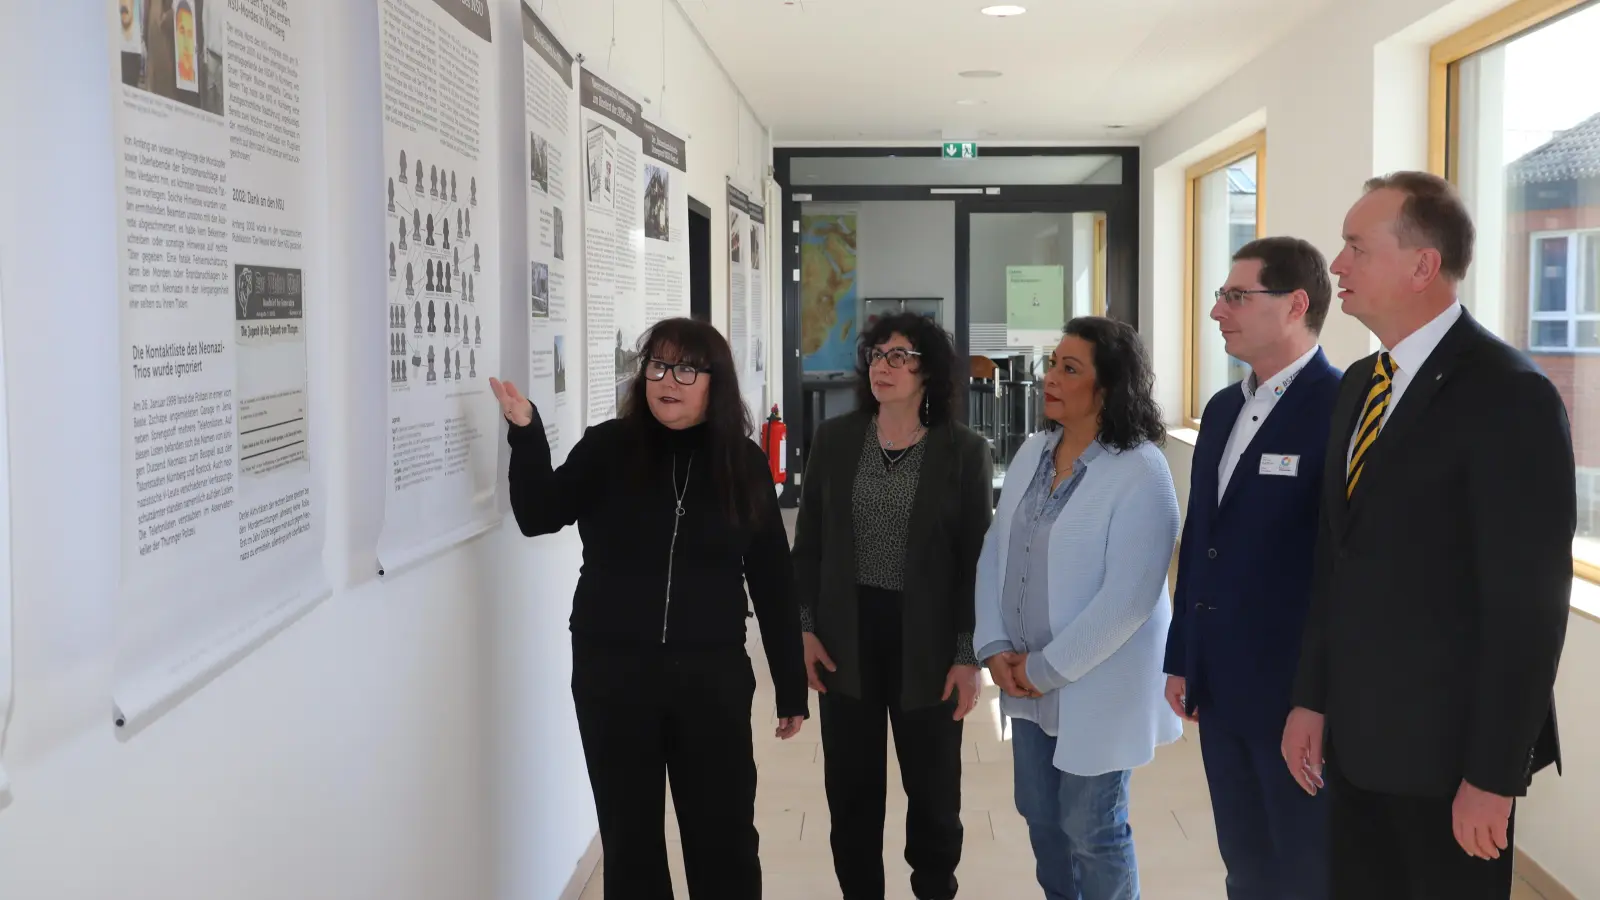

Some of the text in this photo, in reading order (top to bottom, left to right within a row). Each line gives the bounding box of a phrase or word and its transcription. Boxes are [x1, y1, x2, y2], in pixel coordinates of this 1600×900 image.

[471, 0, 483, 16] NSU
[247, 191, 260, 205] Dank
[261, 197, 266, 207] an
[267, 196, 275, 208] den
[276, 198, 284, 210] NSU
[132, 340, 225, 360] Die Kontaktliste des Neonazi-
[133, 360, 202, 379] Trios wurde ignoriert
